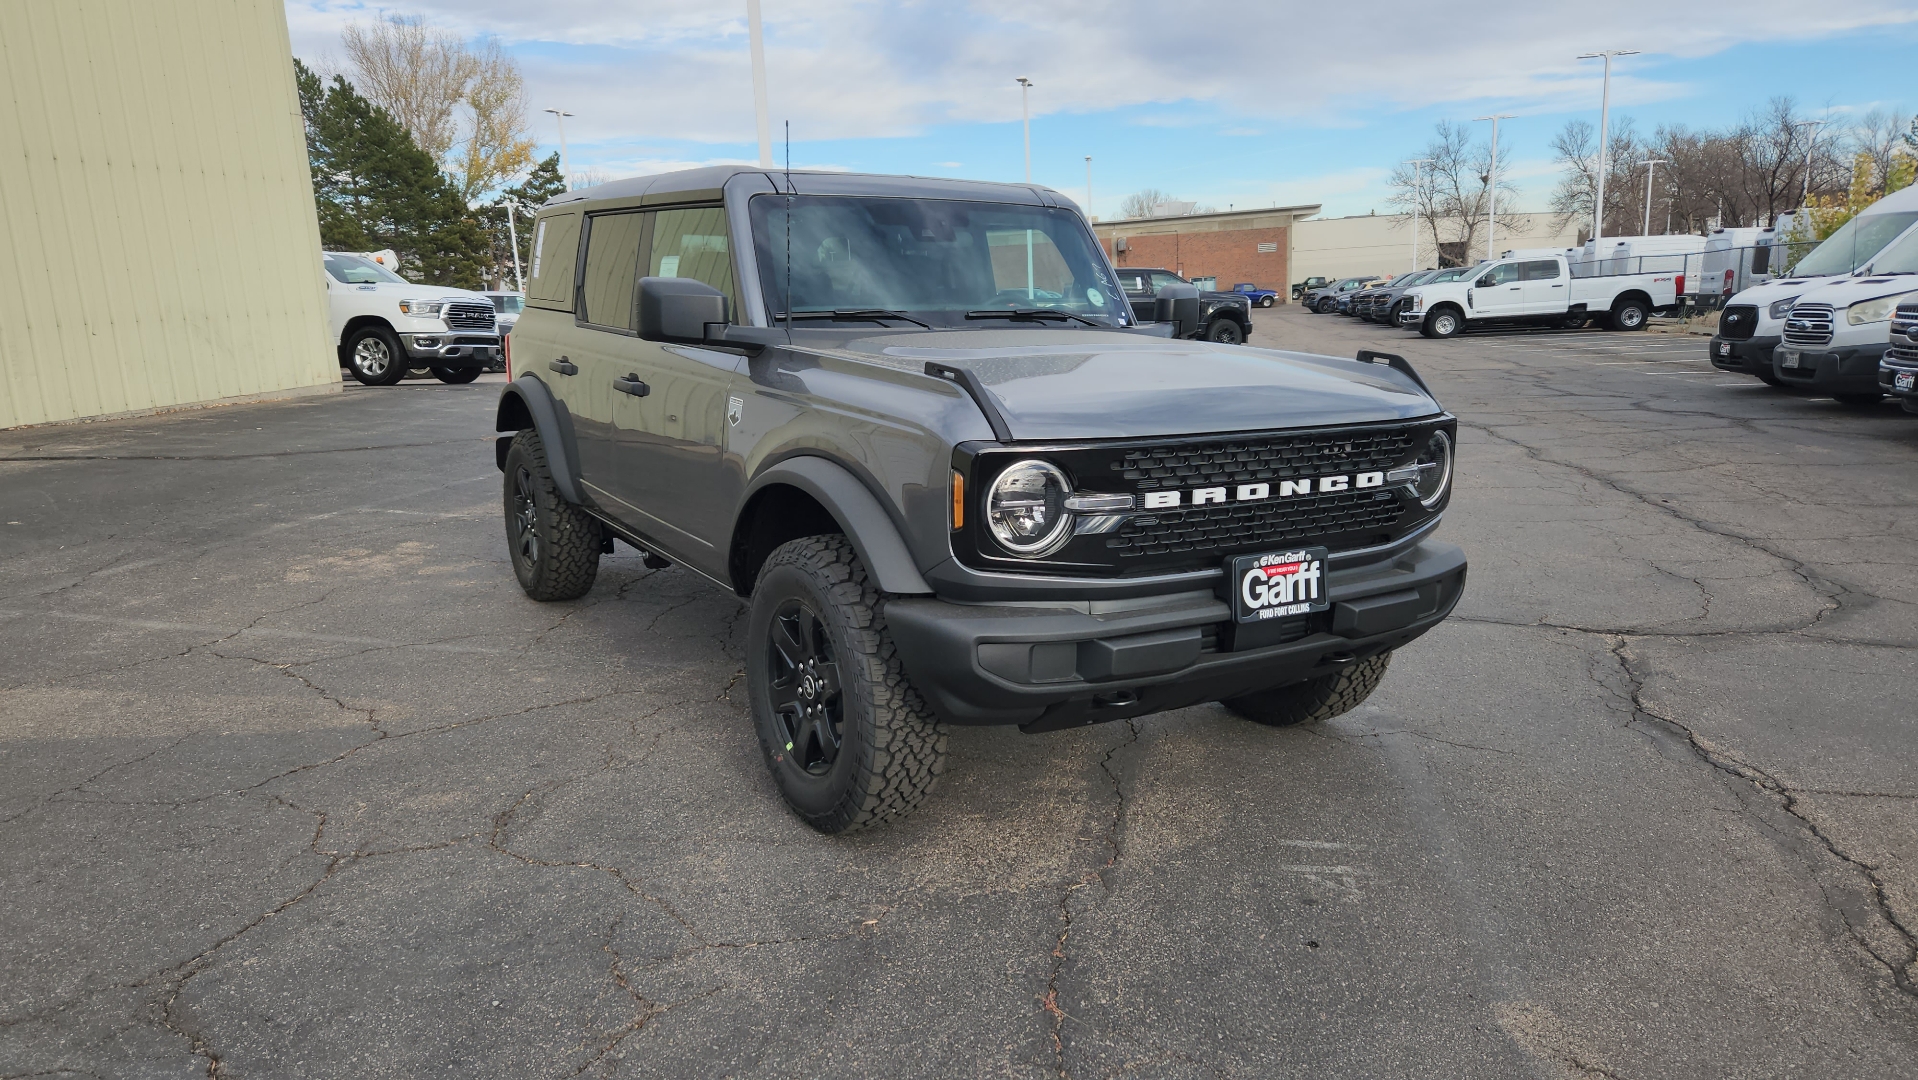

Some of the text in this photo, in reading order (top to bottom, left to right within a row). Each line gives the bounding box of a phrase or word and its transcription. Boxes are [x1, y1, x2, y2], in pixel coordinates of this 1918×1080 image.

[1895, 374, 1915, 389] Garff
[1144, 471, 1384, 509] BRONCO
[1267, 550, 1306, 566] Ken Garff
[1242, 560, 1320, 609] Garff
[1259, 603, 1310, 619] FORD FORT COLLINS
